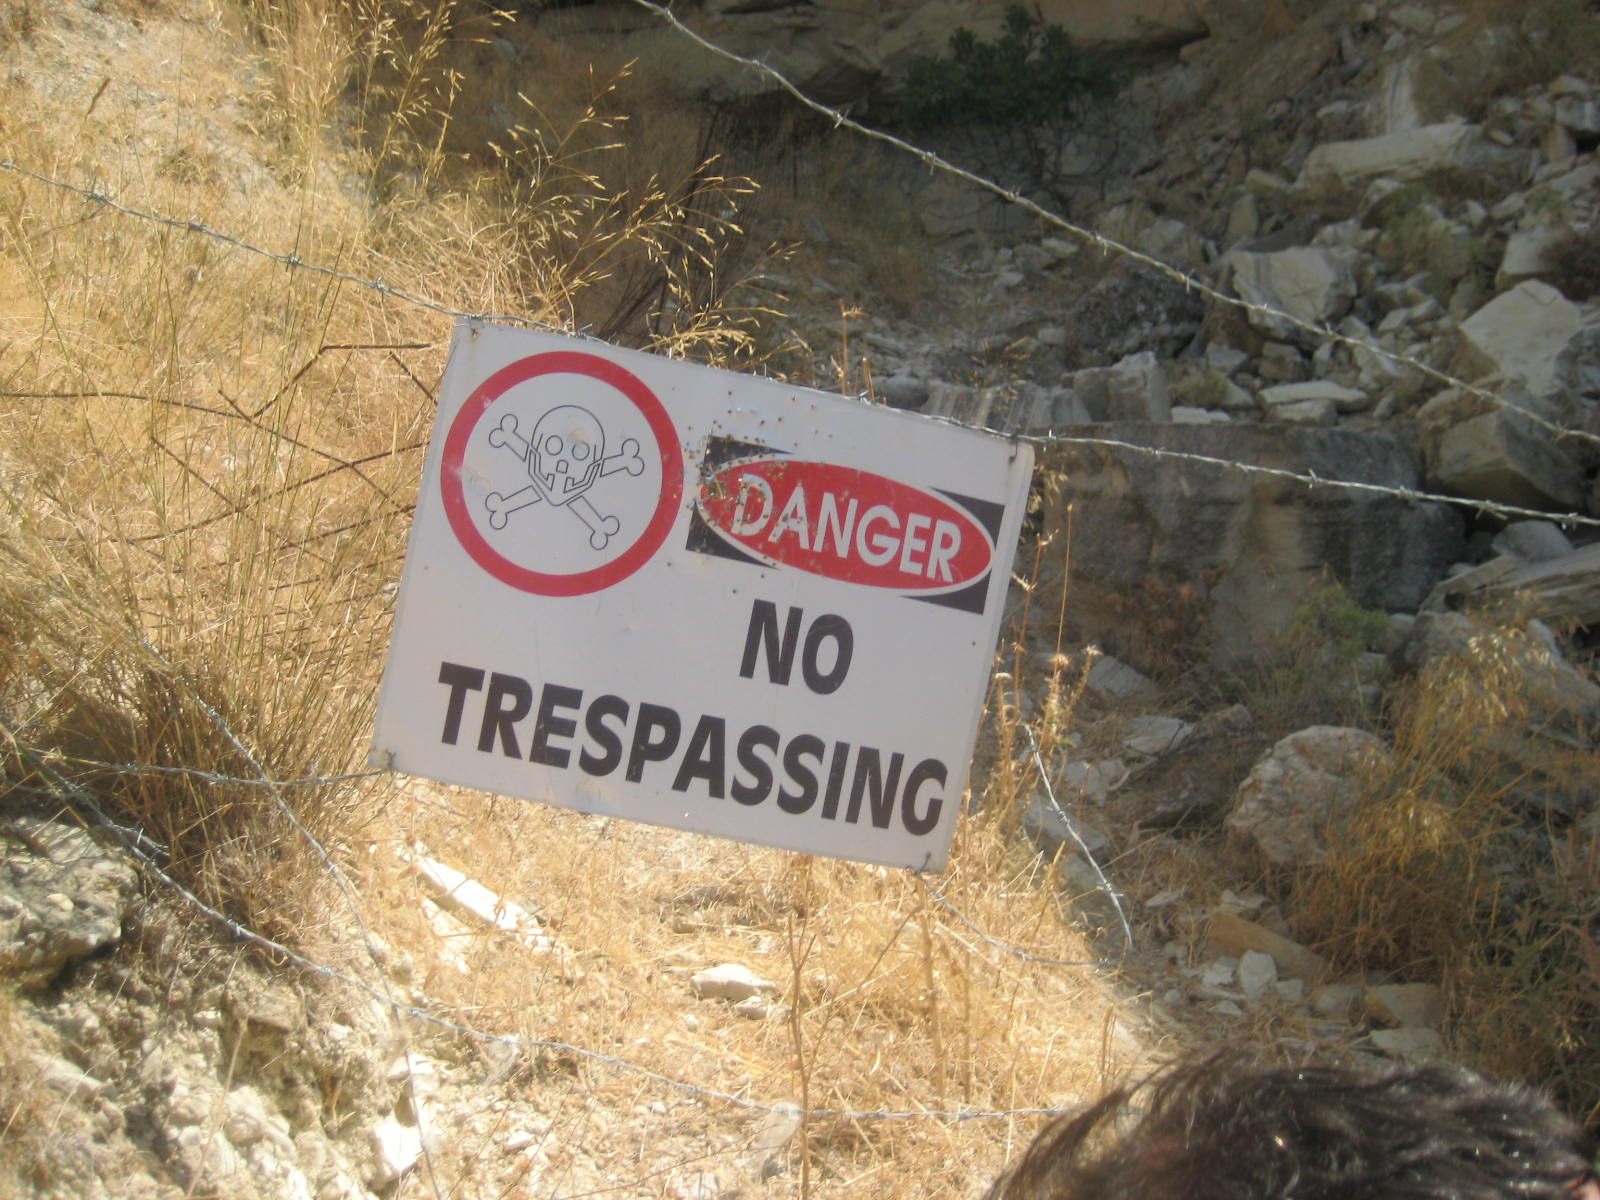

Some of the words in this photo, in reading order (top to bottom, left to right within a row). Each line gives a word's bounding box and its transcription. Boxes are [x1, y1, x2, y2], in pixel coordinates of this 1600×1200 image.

[731, 473, 962, 583] DANGER
[740, 599, 854, 695] NO
[438, 661, 948, 836] TRESPASSING
